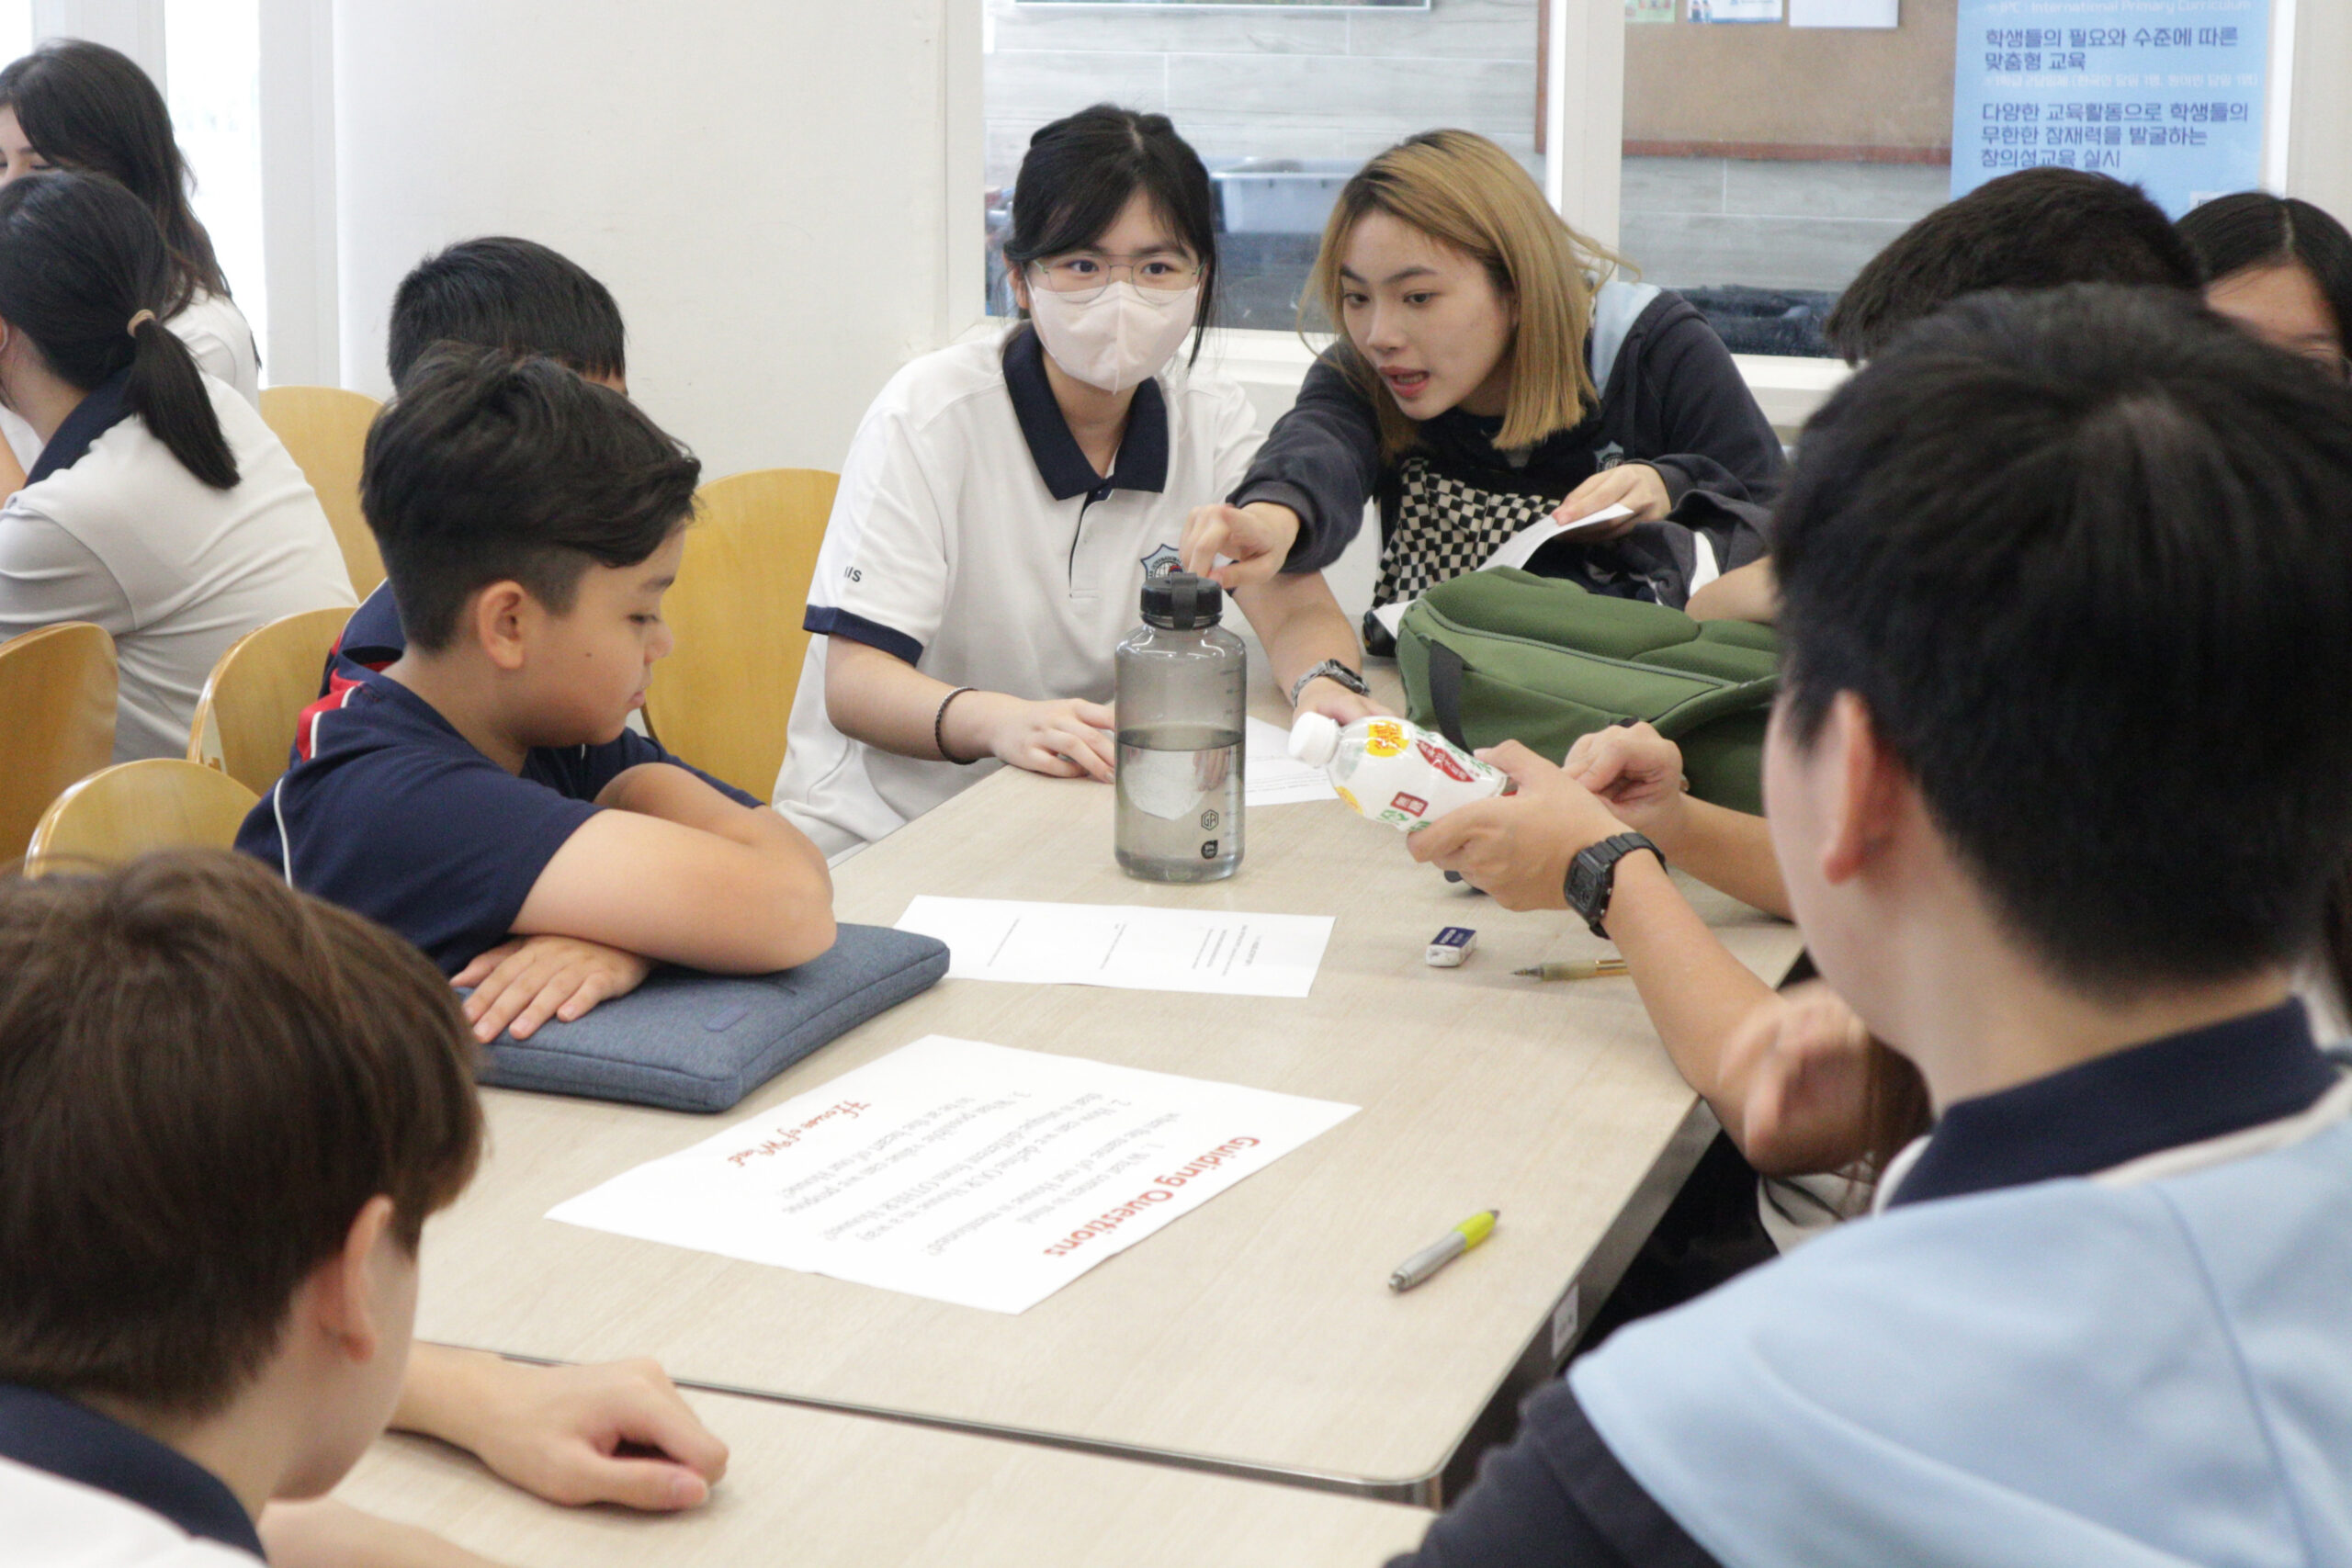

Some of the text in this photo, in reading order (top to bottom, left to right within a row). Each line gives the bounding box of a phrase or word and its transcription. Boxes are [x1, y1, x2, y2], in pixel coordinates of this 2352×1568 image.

[1985, 27, 2238, 49] 학생들의 필요와 수준에 따른
[1984, 51, 2086, 71] 맞춤형 교육
[1983, 103, 2248, 122] 다양한 교육활동으로 학생들의
[1982, 126, 2208, 145] 무한한 잠재력을 발굴하는
[2084, 149, 2120, 168] 실시
[728, 1100, 870, 1166] House of Wind
[1044, 1136, 1260, 1256] Guiding Questions
